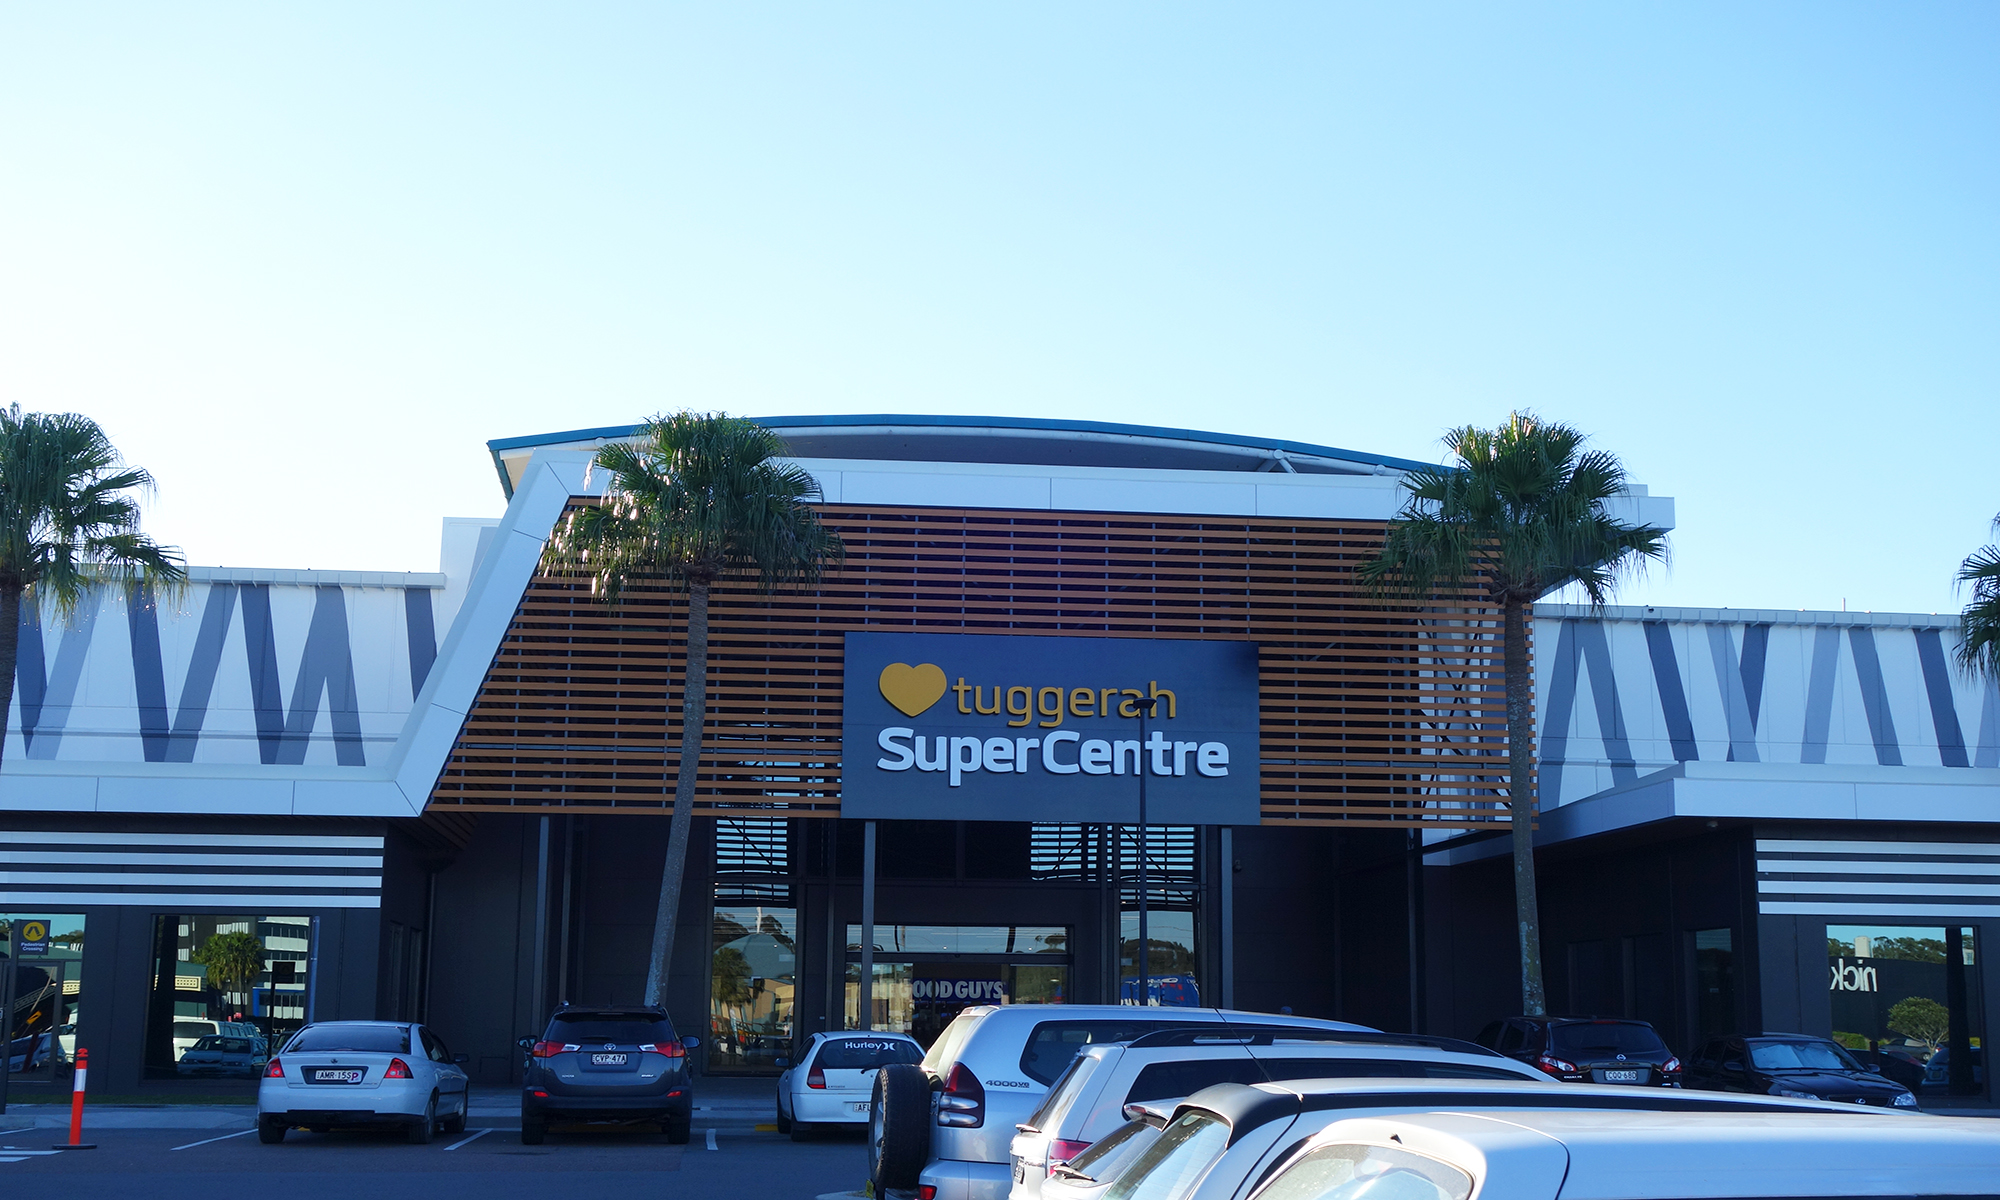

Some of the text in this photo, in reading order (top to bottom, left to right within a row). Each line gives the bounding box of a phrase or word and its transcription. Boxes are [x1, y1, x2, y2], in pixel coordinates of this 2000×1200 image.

[952, 678, 1176, 727] tuggerah
[877, 727, 1229, 786] SuperCentre
[955, 981, 1003, 999] GUYS
[845, 1042, 881, 1050] Hurley
